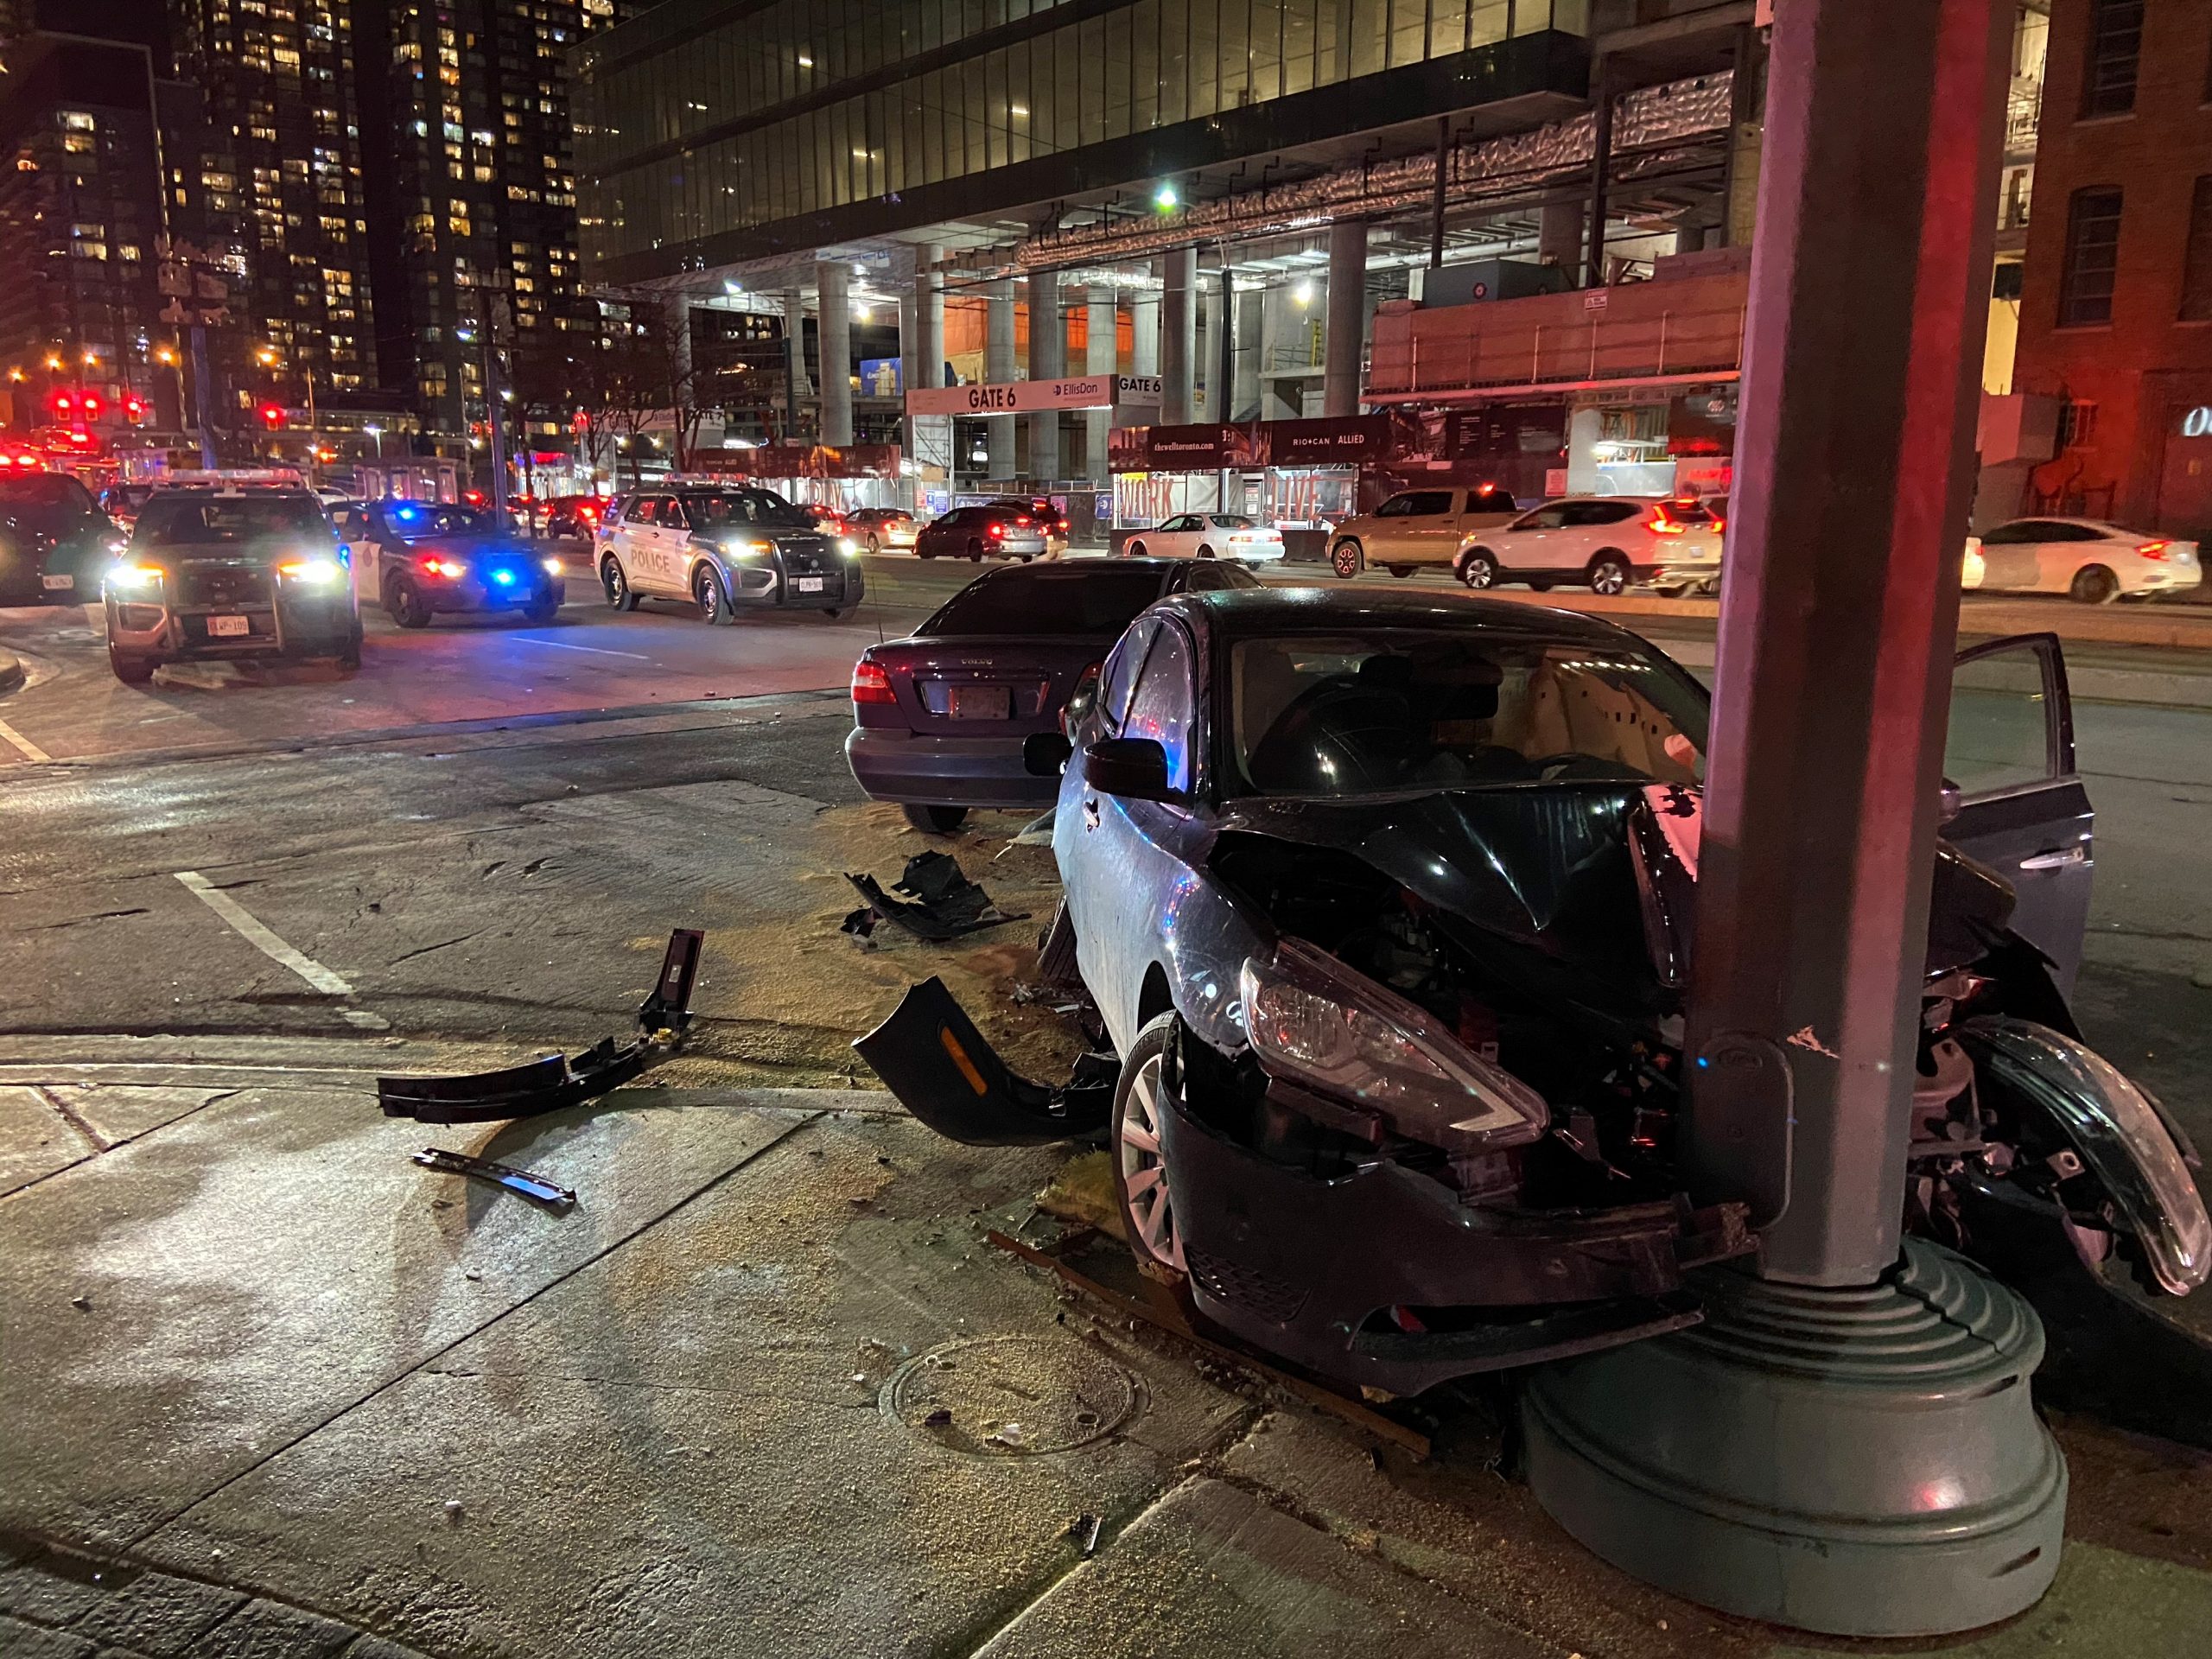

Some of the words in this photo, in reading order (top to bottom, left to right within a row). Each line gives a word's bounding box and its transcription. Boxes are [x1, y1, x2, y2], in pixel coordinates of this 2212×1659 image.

[1064, 383, 1097, 395] EllisDon
[1120, 378, 1150, 391] GATE
[1153, 380, 1161, 392] 6
[969, 388, 1003, 408] GATE
[1007, 387, 1016, 407] 6
[1154, 442, 1214, 451] thewelltoronto.com
[1338, 435, 1365, 445] ALLIED
[1120, 479, 1173, 518] WORK
[1271, 474, 1322, 520] LIVE
[631, 549, 671, 573] POLICE
